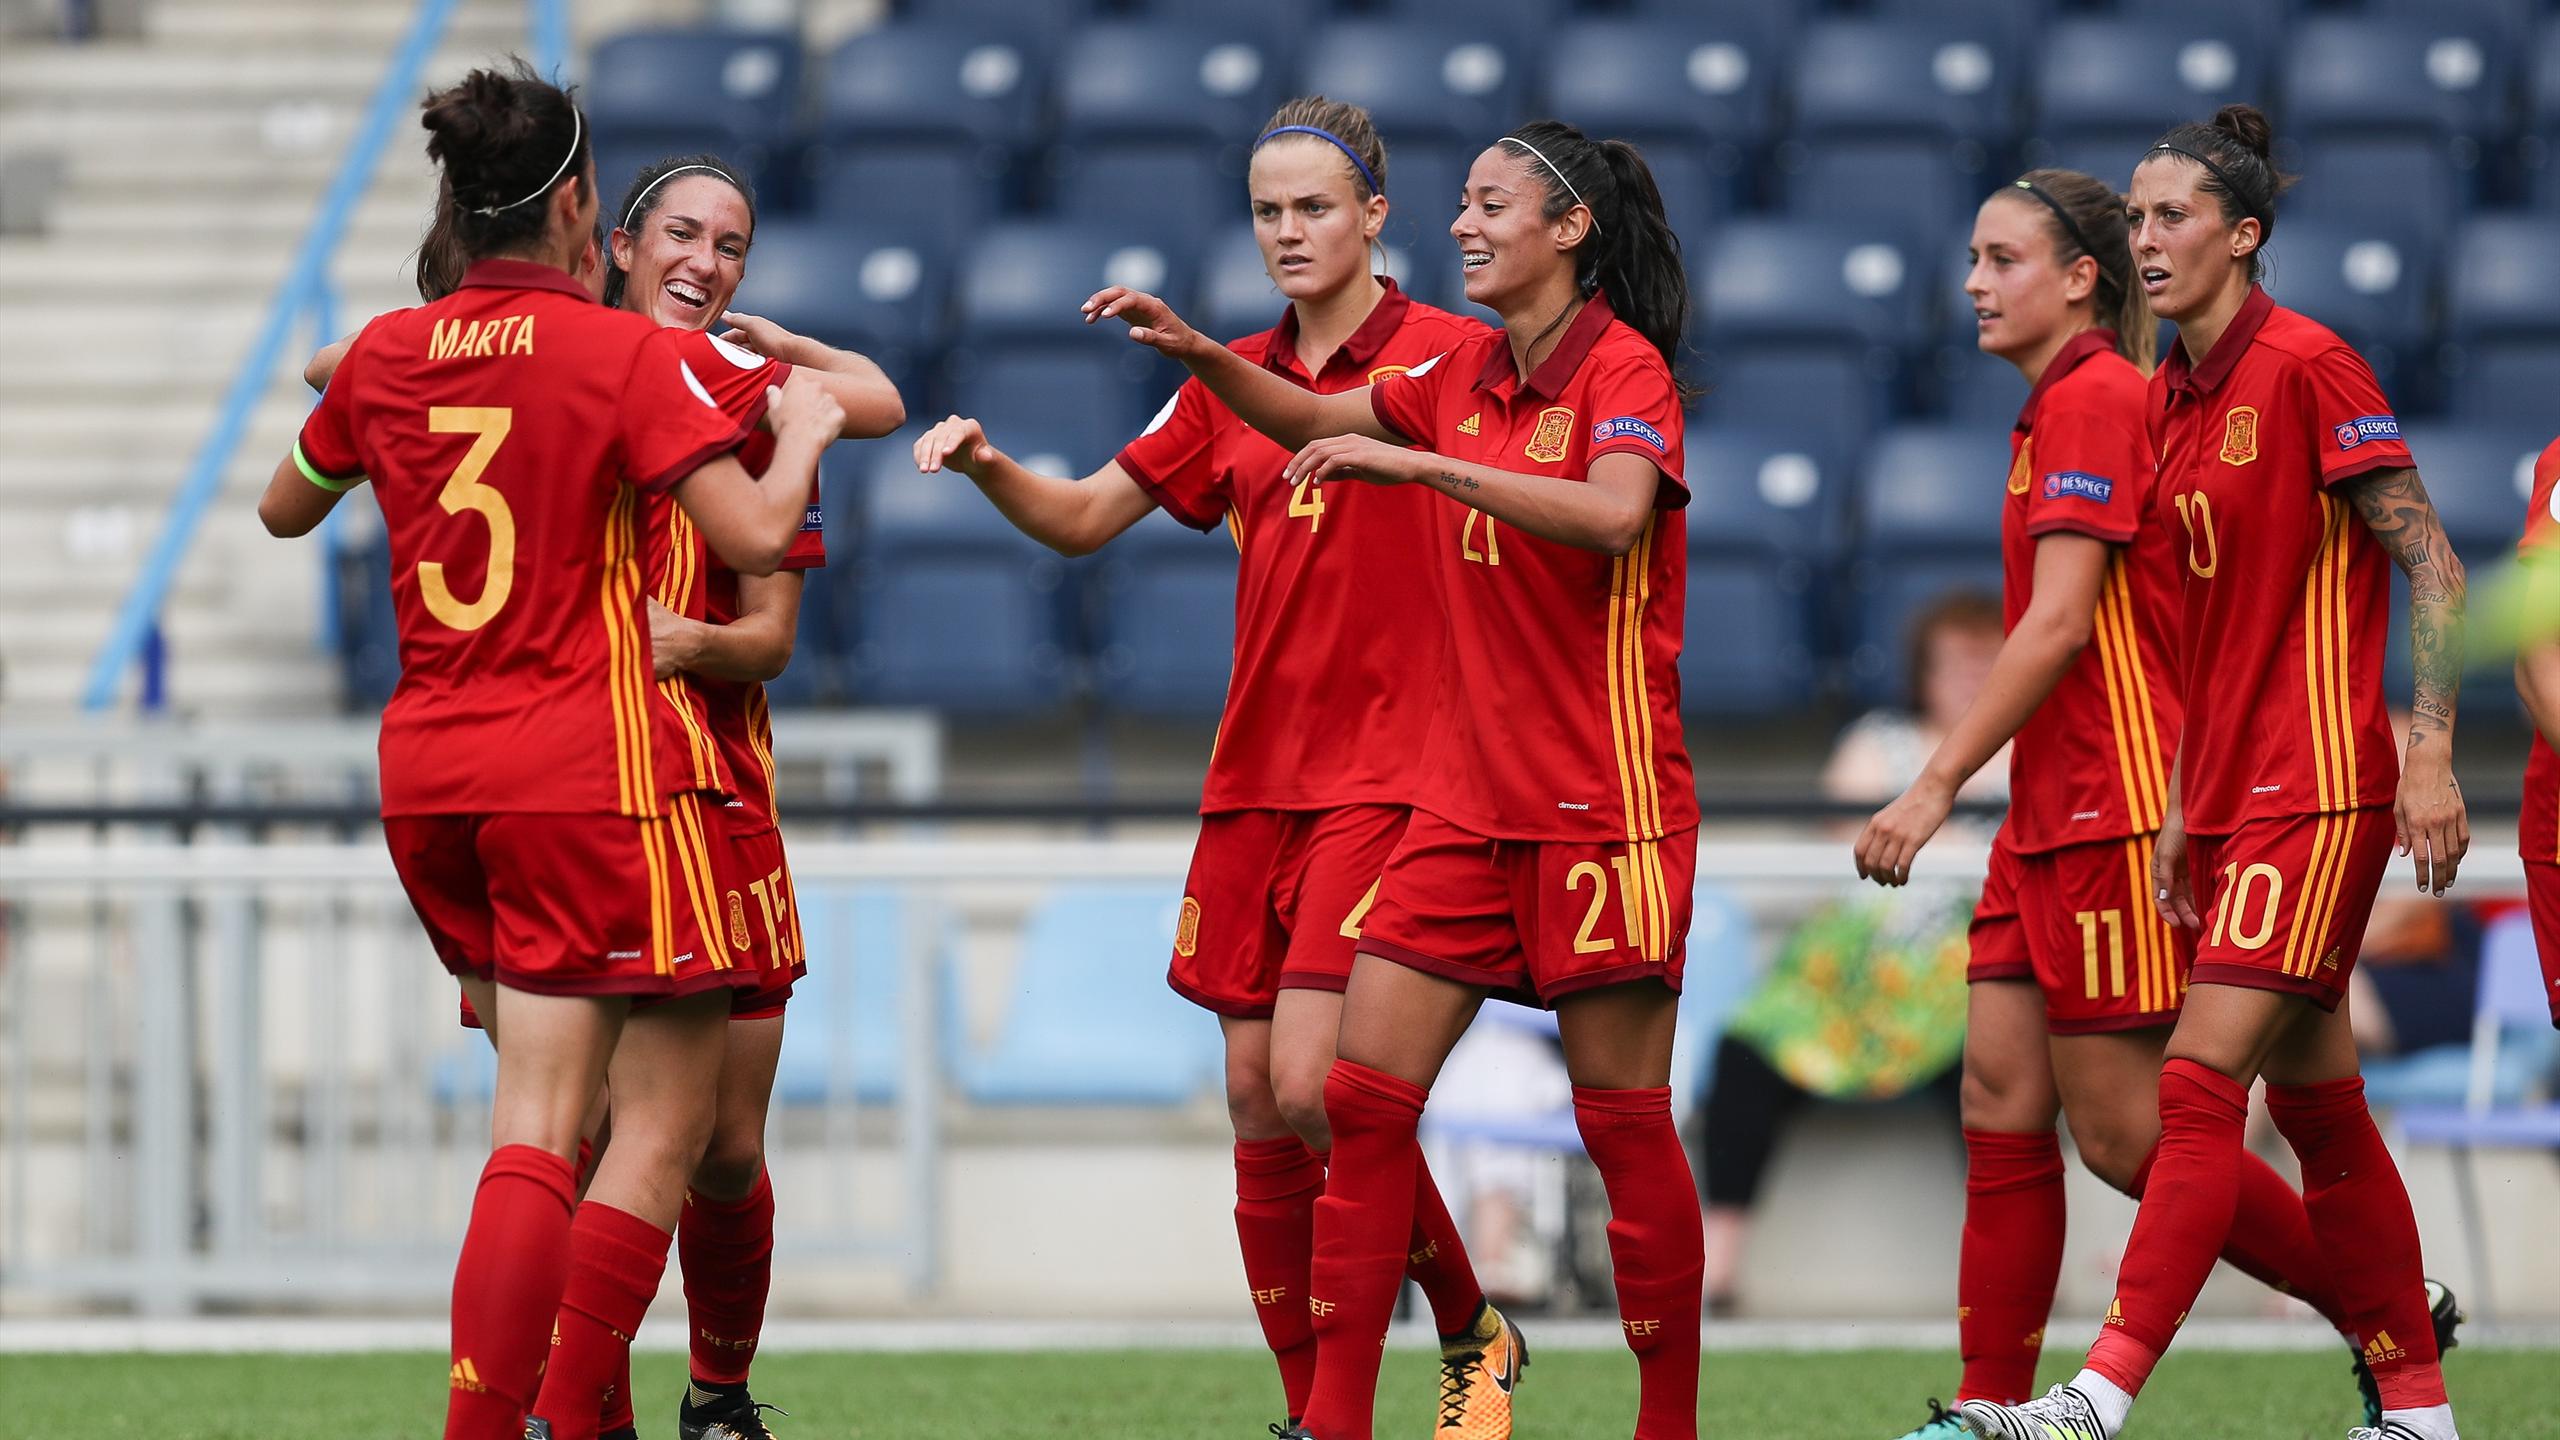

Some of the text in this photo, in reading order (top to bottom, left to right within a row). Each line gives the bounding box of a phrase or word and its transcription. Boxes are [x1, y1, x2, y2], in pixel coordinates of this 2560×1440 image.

[428, 314, 535, 361] MARTA
[1615, 421, 1665, 448] RESPECT
[2358, 421, 2400, 436] RESPECT
[417, 406, 515, 632] 3
[2061, 475, 2111, 498] RESPECT
[2175, 490, 2218, 578] 10
[1566, 855, 1641, 955] 21
[2210, 860, 2284, 951] 10
[2075, 909, 2127, 1000] 11
[1310, 1296, 1336, 1317] EF
